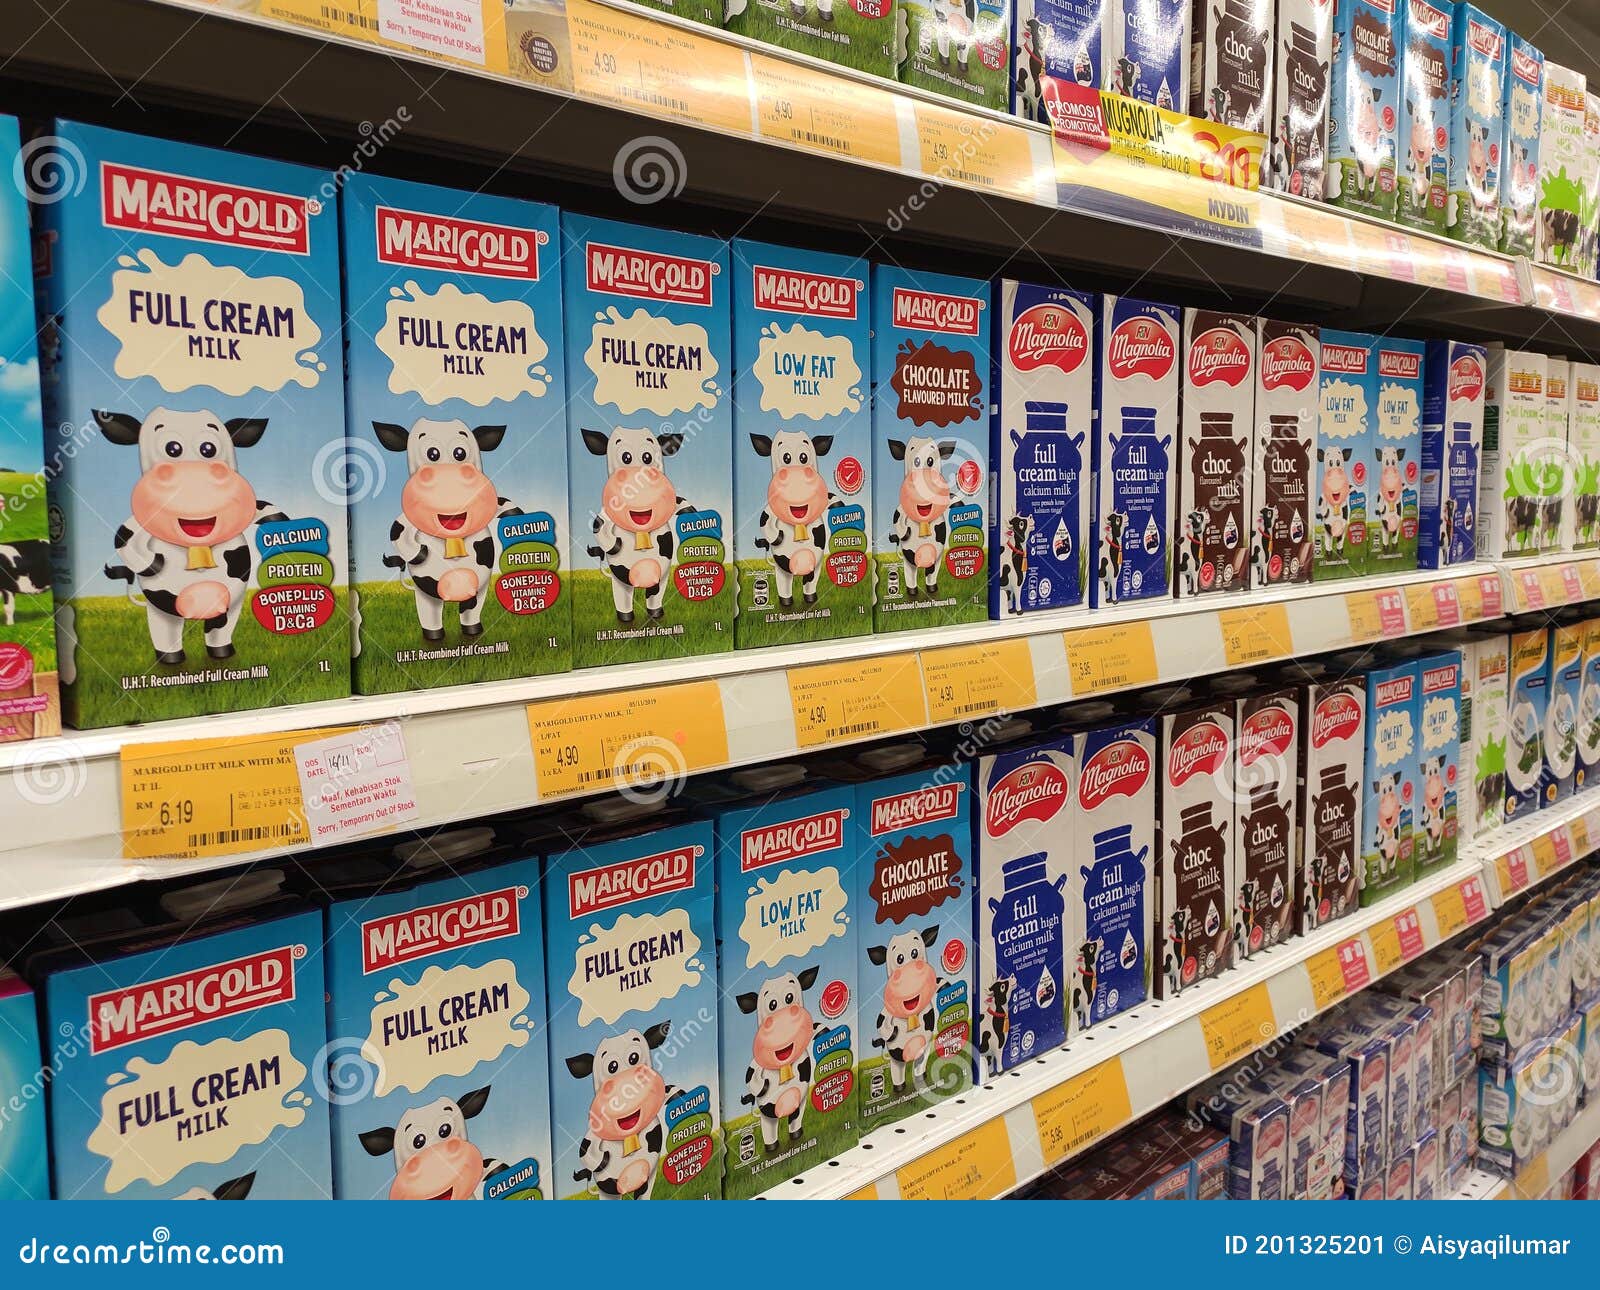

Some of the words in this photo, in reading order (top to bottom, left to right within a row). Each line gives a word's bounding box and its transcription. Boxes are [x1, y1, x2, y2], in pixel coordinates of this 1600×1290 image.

[401, 7, 441, 25] Sementara
[443, 20, 466, 32] Waktu
[455, 11, 472, 23] Stok
[857, 1, 881, 17] D&Ca
[408, 26, 442, 44] Temporary
[444, 36, 455, 46] Out
[465, 42, 482, 53] Stock
[1225, 31, 1253, 63] choc
[594, 52, 617, 74] 4.90
[1376, 51, 1389, 66] MILK
[1294, 63, 1317, 92] choc
[775, 100, 793, 120] 4.90
[1102, 96, 1165, 144] MUGNOLIA
[933, 143, 948, 160] 4.90
[112, 174, 297, 242] MARIGOLD
[1208, 198, 1249, 225] MYDIN
[384, 217, 529, 270] MARIGOLD
[592, 253, 704, 297] MARIGOLD
[759, 273, 850, 311] MARIGOLD
[129, 290, 196, 329] FULL
[204, 299, 295, 339] CREAM
[897, 295, 974, 328] MARIGOLD
[188, 335, 242, 361] MILK
[398, 317, 449, 350] FULL
[455, 323, 527, 355] CREAM
[1014, 323, 1083, 359] Magnolia
[601, 338, 641, 366] FULL
[645, 343, 701, 371] CREAM
[1112, 334, 1171, 368] Magnolia
[1192, 345, 1247, 376] Magnolia
[1321, 347, 1364, 371] MARIGOLD
[444, 355, 485, 376] MILK
[774, 352, 805, 377] LOW
[812, 356, 835, 379] FAT
[902, 364, 969, 390] CHOCOLATE
[1263, 352, 1312, 382] Magnolia
[636, 372, 668, 389] MILK
[794, 380, 820, 395] MILK
[903, 389, 945, 405] FLAVOURED
[947, 393, 969, 406] MILK
[1326, 396, 1341, 411] LOW
[1343, 397, 1355, 412] FAT
[1034, 444, 1057, 464] full
[1128, 446, 1147, 465] full
[1202, 452, 1232, 475] choc
[1271, 453, 1297, 474] choc
[1019, 468, 1057, 482] cream
[1116, 468, 1147, 482] cream
[1283, 479, 1305, 495] milk
[263, 528, 321, 547] CALCIUM
[503, 521, 550, 538] CALCIUM
[680, 518, 717, 533] CALCIUM
[507, 552, 551, 565] PROTEIN
[683, 546, 718, 557] PROTEIN
[268, 564, 323, 578] PROTEIN
[501, 574, 553, 590] BONEPLUS
[678, 566, 720, 579] BONEPLUS
[259, 589, 325, 606] BONEPLUS
[688, 585, 713, 598] D&Ca
[272, 603, 317, 615] VITAMINS
[514, 597, 545, 612] D&Ca
[275, 613, 315, 631] D&Ca
[396, 651, 418, 663] U.H.T.
[418, 646, 460, 661] Recombined
[474, 643, 495, 656] Cream
[122, 675, 149, 690] U.H.T.
[150, 670, 205, 688] Recombined
[223, 667, 249, 681] Cream
[940, 685, 954, 702] 4.90
[535, 716, 573, 728] MARIGOLD
[810, 705, 827, 724] 4.90
[1313, 709, 1359, 741] Magnolia
[540, 747, 552, 756] RM
[557, 745, 579, 767] 4.90
[1171, 736, 1225, 777] Magnolia
[133, 764, 192, 776] MARIGOLD
[195, 762, 216, 771] UHT
[218, 760, 245, 770] MILK
[247, 757, 274, 767] WITH
[307, 767, 327, 778] DATE:
[1083, 755, 1146, 800] Magnolia
[321, 792, 343, 803] Maaf,
[344, 781, 383, 800] Kehabisan
[384, 776, 401, 787] Stok
[330, 795, 372, 813] Sementara
[373, 789, 397, 801] Waktu
[989, 776, 1063, 826] Magnolia
[136, 801, 153, 810] RM
[160, 800, 193, 826] 6.19
[317, 822, 339, 835] Sorry,
[339, 811, 375, 830] Temporary
[375, 807, 388, 818] Out
[388, 805, 397, 815] Of
[397, 800, 416, 813] Stock
[875, 790, 952, 828] MARIGOLD
[1321, 802, 1345, 824] choc
[746, 817, 837, 863] MARIGOLD
[1252, 822, 1278, 846] choc
[881, 851, 948, 889] CHOCOLATE
[1183, 846, 1212, 871] choc
[574, 854, 688, 910] MARIGOLD
[1102, 864, 1122, 888] full
[882, 881, 926, 906] FLAVOURED
[928, 874, 948, 894] MILK
[1089, 887, 1123, 909] cream
[1125, 881, 1140, 896] high
[760, 897, 793, 927] LOW
[797, 889, 822, 914] FAT
[1013, 895, 1038, 921] full
[369, 897, 509, 963] MARIGOLD
[779, 919, 806, 939] MILK
[998, 919, 1039, 944] cream
[1040, 914, 1059, 930] high
[1036, 930, 1054, 945] milk
[584, 949, 624, 982] FULL
[628, 930, 684, 964] CREAM
[619, 967, 652, 992] MILK
[100, 959, 282, 1043] MARIGOLD
[383, 1006, 433, 1046] FULL
[439, 983, 509, 1027] CREAM
[941, 1008, 965, 1024] PROTEIN
[427, 1026, 469, 1055] MILK
[816, 1031, 847, 1054] CALCIUM
[944, 1042, 962, 1057] D&Ca
[819, 1056, 848, 1074] PROTEIN
[119, 1086, 184, 1134] FULL
[192, 1055, 281, 1108] CREAM
[815, 1073, 849, 1097] BONEPLUS
[669, 1092, 706, 1121] CALCIUM
[177, 1106, 229, 1141] MILK
[672, 1120, 706, 1143] PROTEIN
[1050, 1125, 1064, 1144] 5.95
[667, 1139, 708, 1166] BONEPLUS
